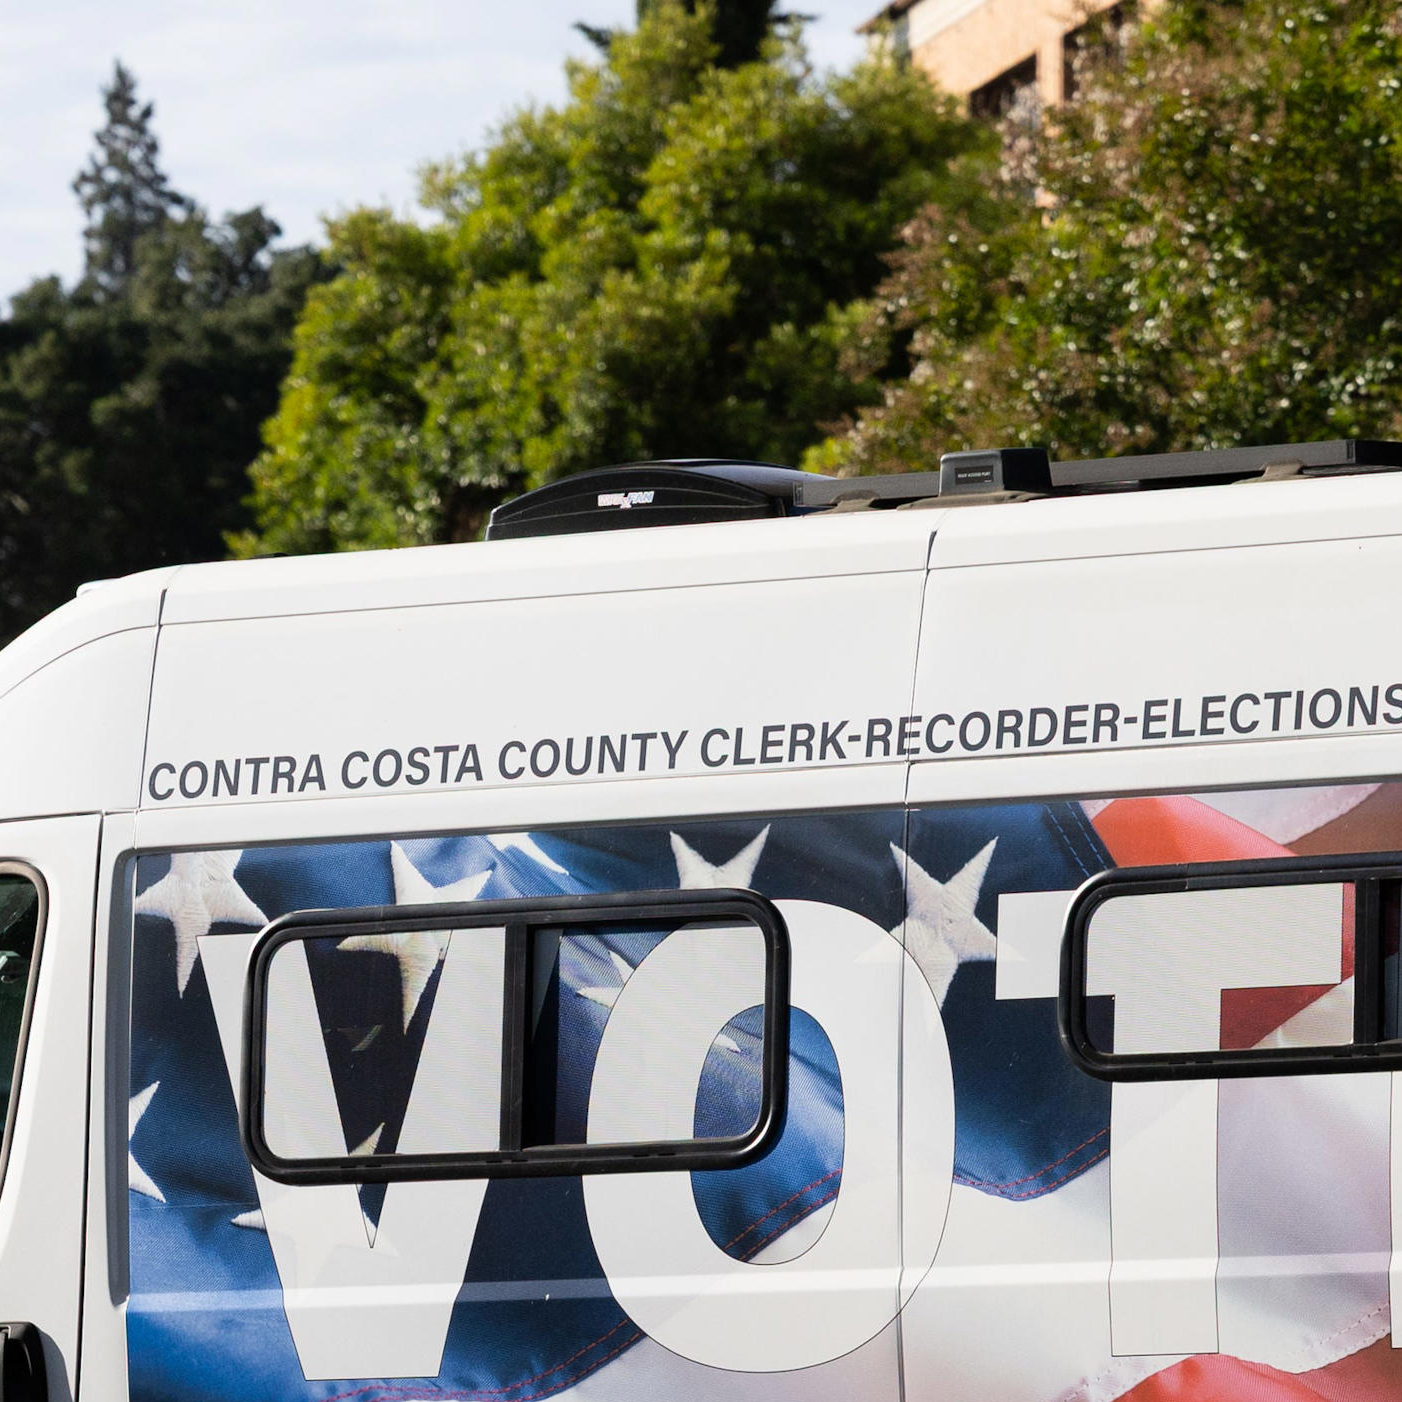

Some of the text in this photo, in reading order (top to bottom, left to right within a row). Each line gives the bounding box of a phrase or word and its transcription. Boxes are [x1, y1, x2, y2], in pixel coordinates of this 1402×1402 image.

[148, 754, 326, 801] CONTRA
[341, 743, 483, 789] COSTA
[498, 730, 689, 780] COUNTY
